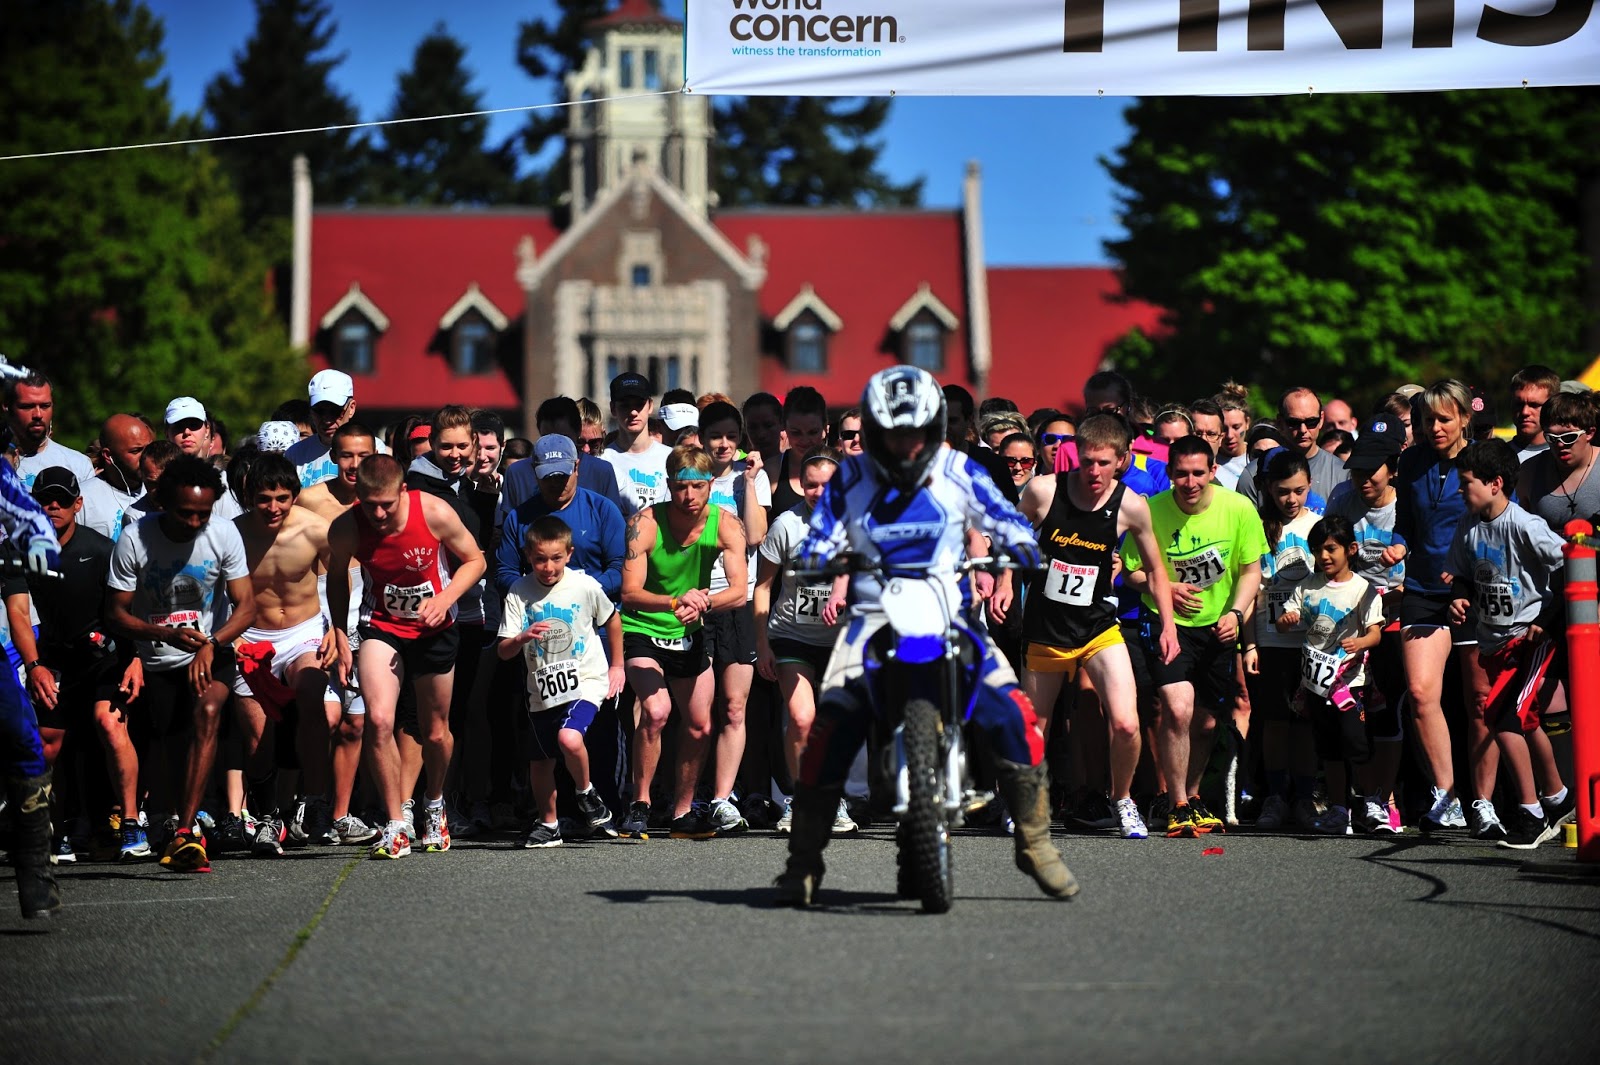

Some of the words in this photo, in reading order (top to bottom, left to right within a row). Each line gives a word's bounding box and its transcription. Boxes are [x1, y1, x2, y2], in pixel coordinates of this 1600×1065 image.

[730, 14, 897, 42] concern
[732, 46, 774, 56] witness
[777, 46, 795, 56] the
[799, 46, 881, 57] transformation
[545, 451, 563, 459] NIKE
[635, 487, 648, 495] HEM
[1050, 528, 1107, 552] Inglemoor
[403, 547, 433, 560] KINGS
[1188, 554, 1206, 565] THEM
[1206, 549, 1216, 559] 5K
[1053, 561, 1069, 574] FREE
[1070, 566, 1087, 576] THEM
[1087, 567, 1095, 576] 5K
[1175, 556, 1226, 584] 2371
[403, 587, 421, 596] THEM
[800, 587, 816, 596] FREE
[1058, 573, 1084, 597] 12
[1481, 585, 1498, 594] THEM
[1500, 586, 1509, 594] 5K
[386, 591, 433, 612] 272
[1268, 592, 1282, 600] FREE
[151, 614, 168, 624] FREE
[168, 613, 188, 623] THEM
[188, 611, 199, 620] 5K
[1312, 651, 1328, 663] THEM
[1328, 658, 1337, 666] 5K
[536, 666, 549, 677] FREE
[548, 662, 565, 674] THEM
[566, 660, 575, 668] 5K
[537, 668, 579, 701] 2605
